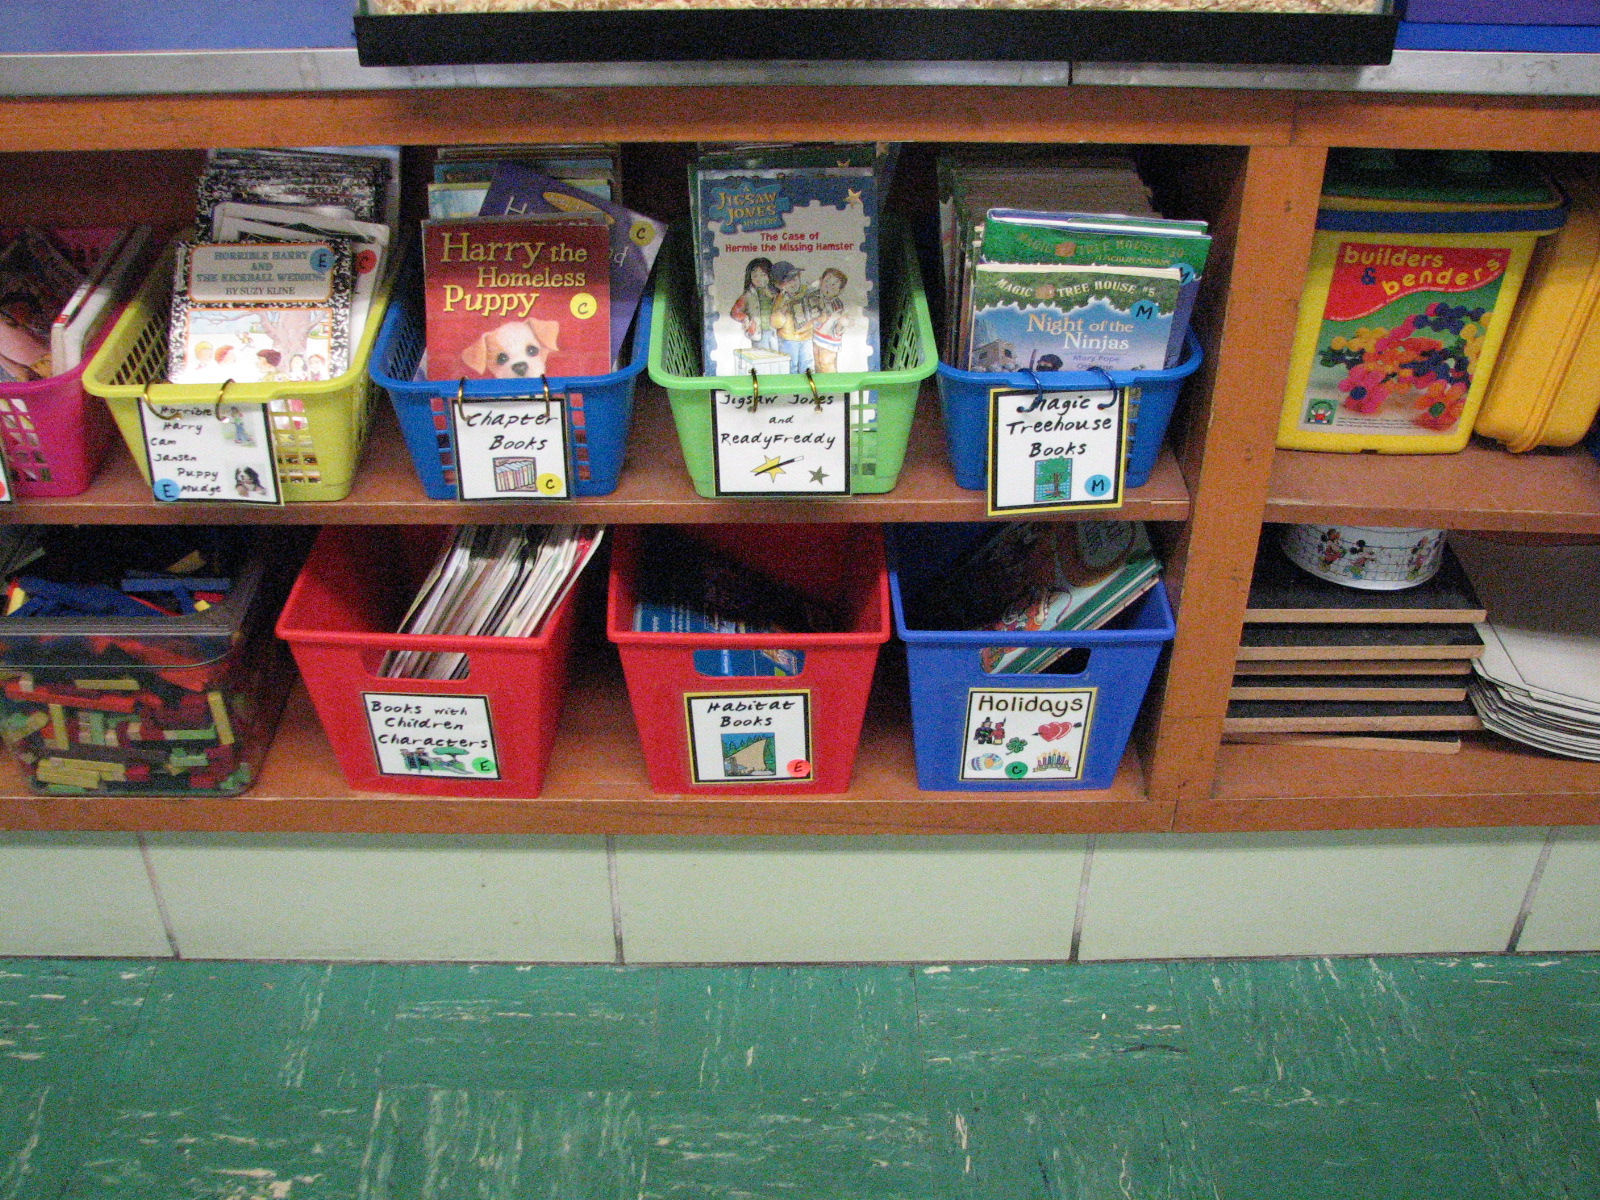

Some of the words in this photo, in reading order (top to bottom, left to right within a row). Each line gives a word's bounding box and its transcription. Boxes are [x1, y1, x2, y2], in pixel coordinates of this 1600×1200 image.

[717, 192, 777, 210] JIGSAW
[726, 205, 776, 226] JONES
[761, 232, 778, 241] The
[782, 232, 805, 240] Case
[809, 232, 820, 240] of
[440, 232, 545, 269] Harry
[551, 243, 588, 262] the
[725, 243, 758, 253] Hermie
[761, 243, 776, 252] the
[780, 242, 814, 252] Missing
[816, 242, 854, 251] Hamster
[214, 252, 268, 260] HORRIBLE
[272, 251, 309, 260] HARRY
[318, 253, 328, 268] E
[1344, 246, 1443, 268] builders
[251, 263, 273, 271] AND
[196, 274, 218, 282] THE
[221, 273, 274, 282] KICKBALL
[277, 273, 326, 282] WEDDING
[477, 267, 586, 288] Homeless
[1361, 267, 1377, 285] &
[1382, 259, 1500, 296] benders
[226, 288, 240, 296] BY
[267, 287, 295, 295] KLINE
[995, 278, 1033, 297] MAGIC
[1057, 283, 1090, 298] TREE
[1094, 280, 1138, 294] HOUSE
[1142, 287, 1155, 297] #5
[443, 285, 539, 317] Puppy
[1135, 305, 1153, 320] M
[1026, 313, 1085, 335] Night
[1089, 320, 1107, 332] of
[1109, 320, 1134, 332] the
[1064, 332, 1129, 352] Ninjas
[719, 394, 778, 409] Jigsaw
[789, 394, 834, 405] Jones
[160, 406, 212, 416] Horrible
[466, 411, 558, 429] Chapter
[769, 415, 795, 424] and
[1006, 416, 1112, 435] Treehouse
[163, 422, 203, 435] Harry
[150, 437, 177, 446] Cam
[489, 435, 548, 450] Books
[1029, 442, 1087, 458] Books
[154, 453, 197, 462] Jansen
[177, 468, 219, 481] Puppy
[162, 484, 176, 498] E
[546, 479, 555, 489] C
[1091, 479, 1104, 492] M
[371, 700, 422, 714] Books
[434, 707, 467, 716] with
[707, 700, 795, 713] Habitat
[979, 695, 1083, 717] Holidays
[384, 717, 464, 731] Children
[720, 716, 773, 727] Books
[378, 734, 488, 748] Characters
[479, 759, 490, 772] E
[793, 761, 803, 773] E
